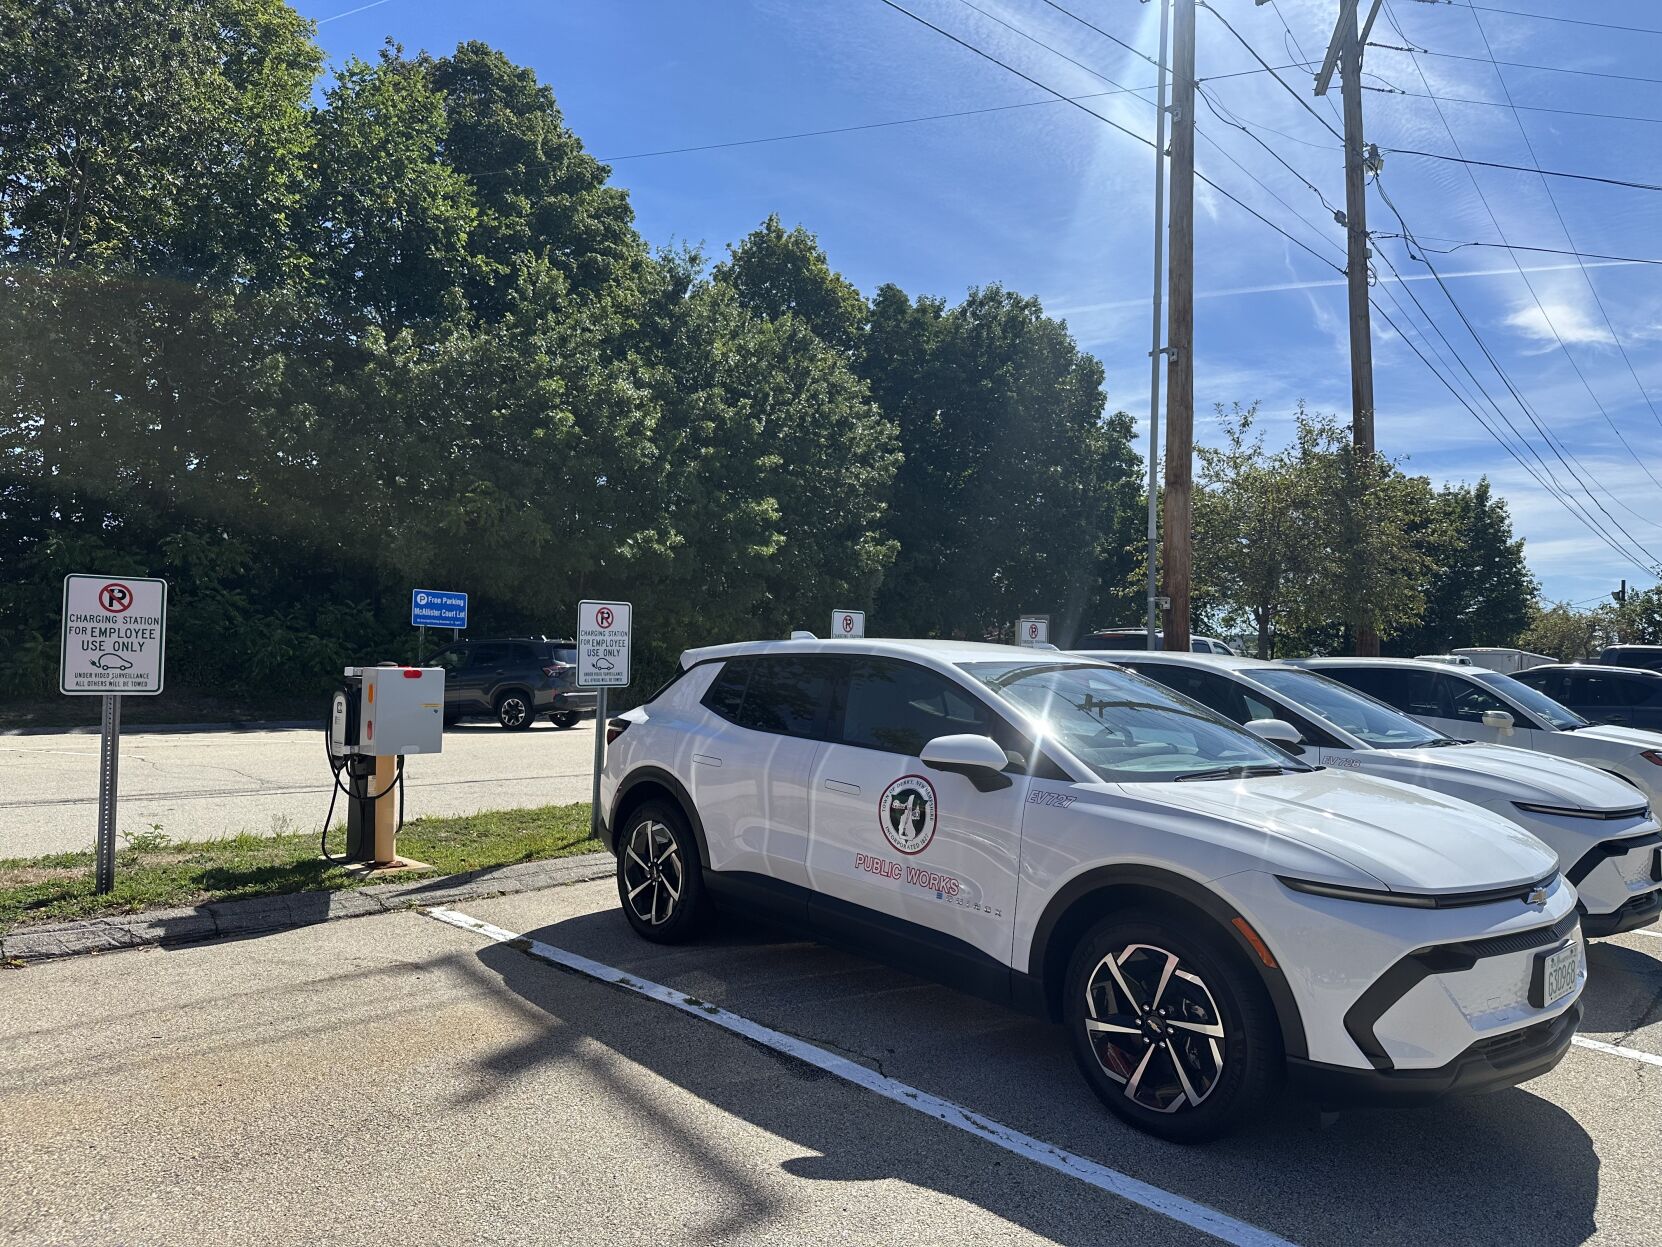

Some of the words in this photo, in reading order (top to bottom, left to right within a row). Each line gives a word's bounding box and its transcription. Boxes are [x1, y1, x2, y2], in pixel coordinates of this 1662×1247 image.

[428, 596, 441, 604] Free
[442, 598, 464, 606] Parking
[414, 608, 441, 616] McAllister
[69, 614, 118, 624] CHARGING
[122, 616, 160, 625] STATION
[68, 626, 87, 635] FOR
[91, 627, 156, 639] EMPLOYEE
[81, 640, 105, 651] USE
[113, 641, 145, 652] ONLY
[592, 639, 626, 648] EMPLOYEE
[587, 648, 600, 656] USE
[603, 649, 621, 657] ONLY
[882, 794, 890, 812] TOWN
[916, 780, 926, 789] NEW
[1026, 789, 1078, 809] EV727
[885, 826, 920, 850] INCORPORATED
[855, 853, 902, 880] PUBLIC
[906, 866, 960, 896] WORKS
